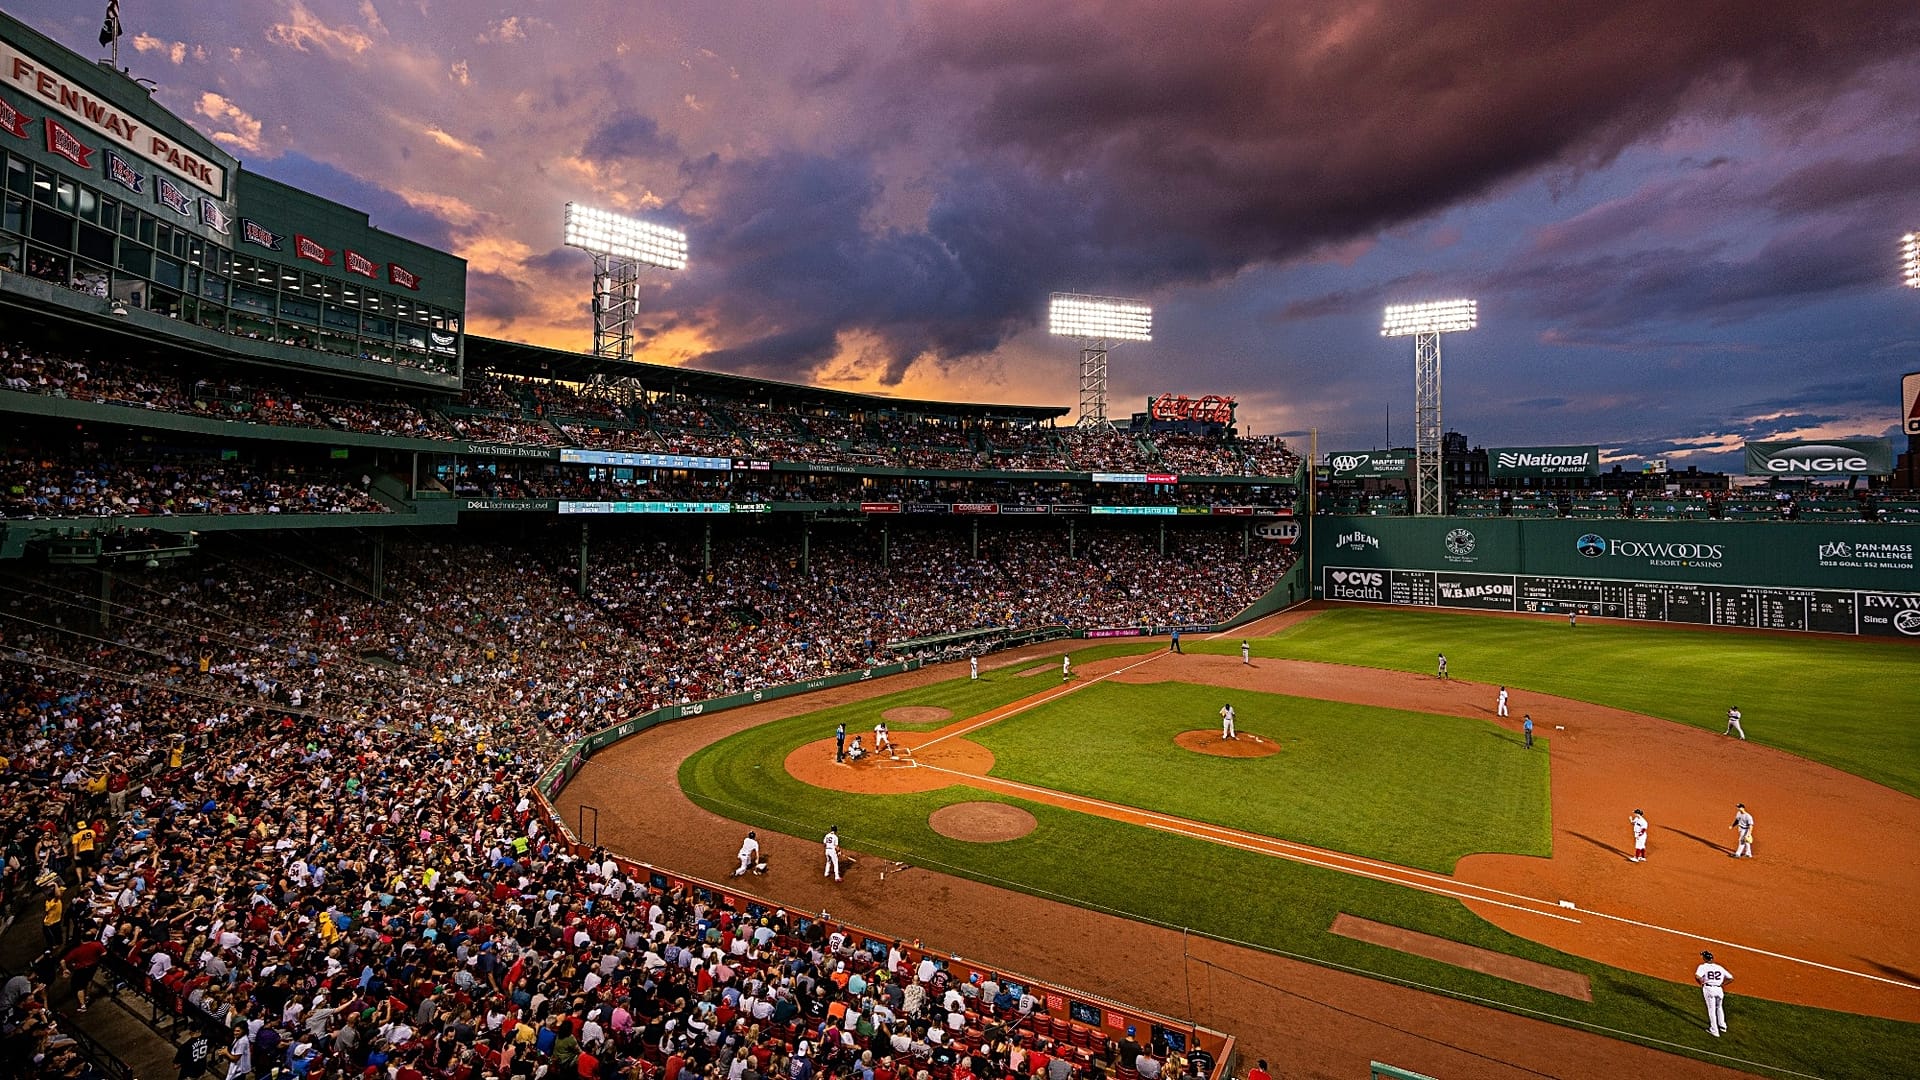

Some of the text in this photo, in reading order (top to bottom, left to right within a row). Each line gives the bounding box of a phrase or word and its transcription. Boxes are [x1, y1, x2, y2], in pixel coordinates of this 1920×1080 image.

[13, 57, 139, 142] FENWAY
[152, 136, 214, 186] PARK
[468, 445, 550, 457] STATE STREET PAVILION
[467, 501, 489, 509] DELL
[488, 501, 531, 511] Technologies
[1256, 523, 1297, 536] Gulf
[1336, 531, 1379, 549] JIM BEAM
[1609, 539, 1723, 560] FOXWOODS
[1855, 543, 1912, 552] PAN-MASS
[1855, 551, 1913, 560] CHALLENGE
[1650, 559, 1681, 567] RESORT
[1348, 572, 1383, 586] CVS
[1334, 584, 1383, 600] Health
[1863, 615, 1888, 624] Since
[1707, 970, 1722, 980] 82
